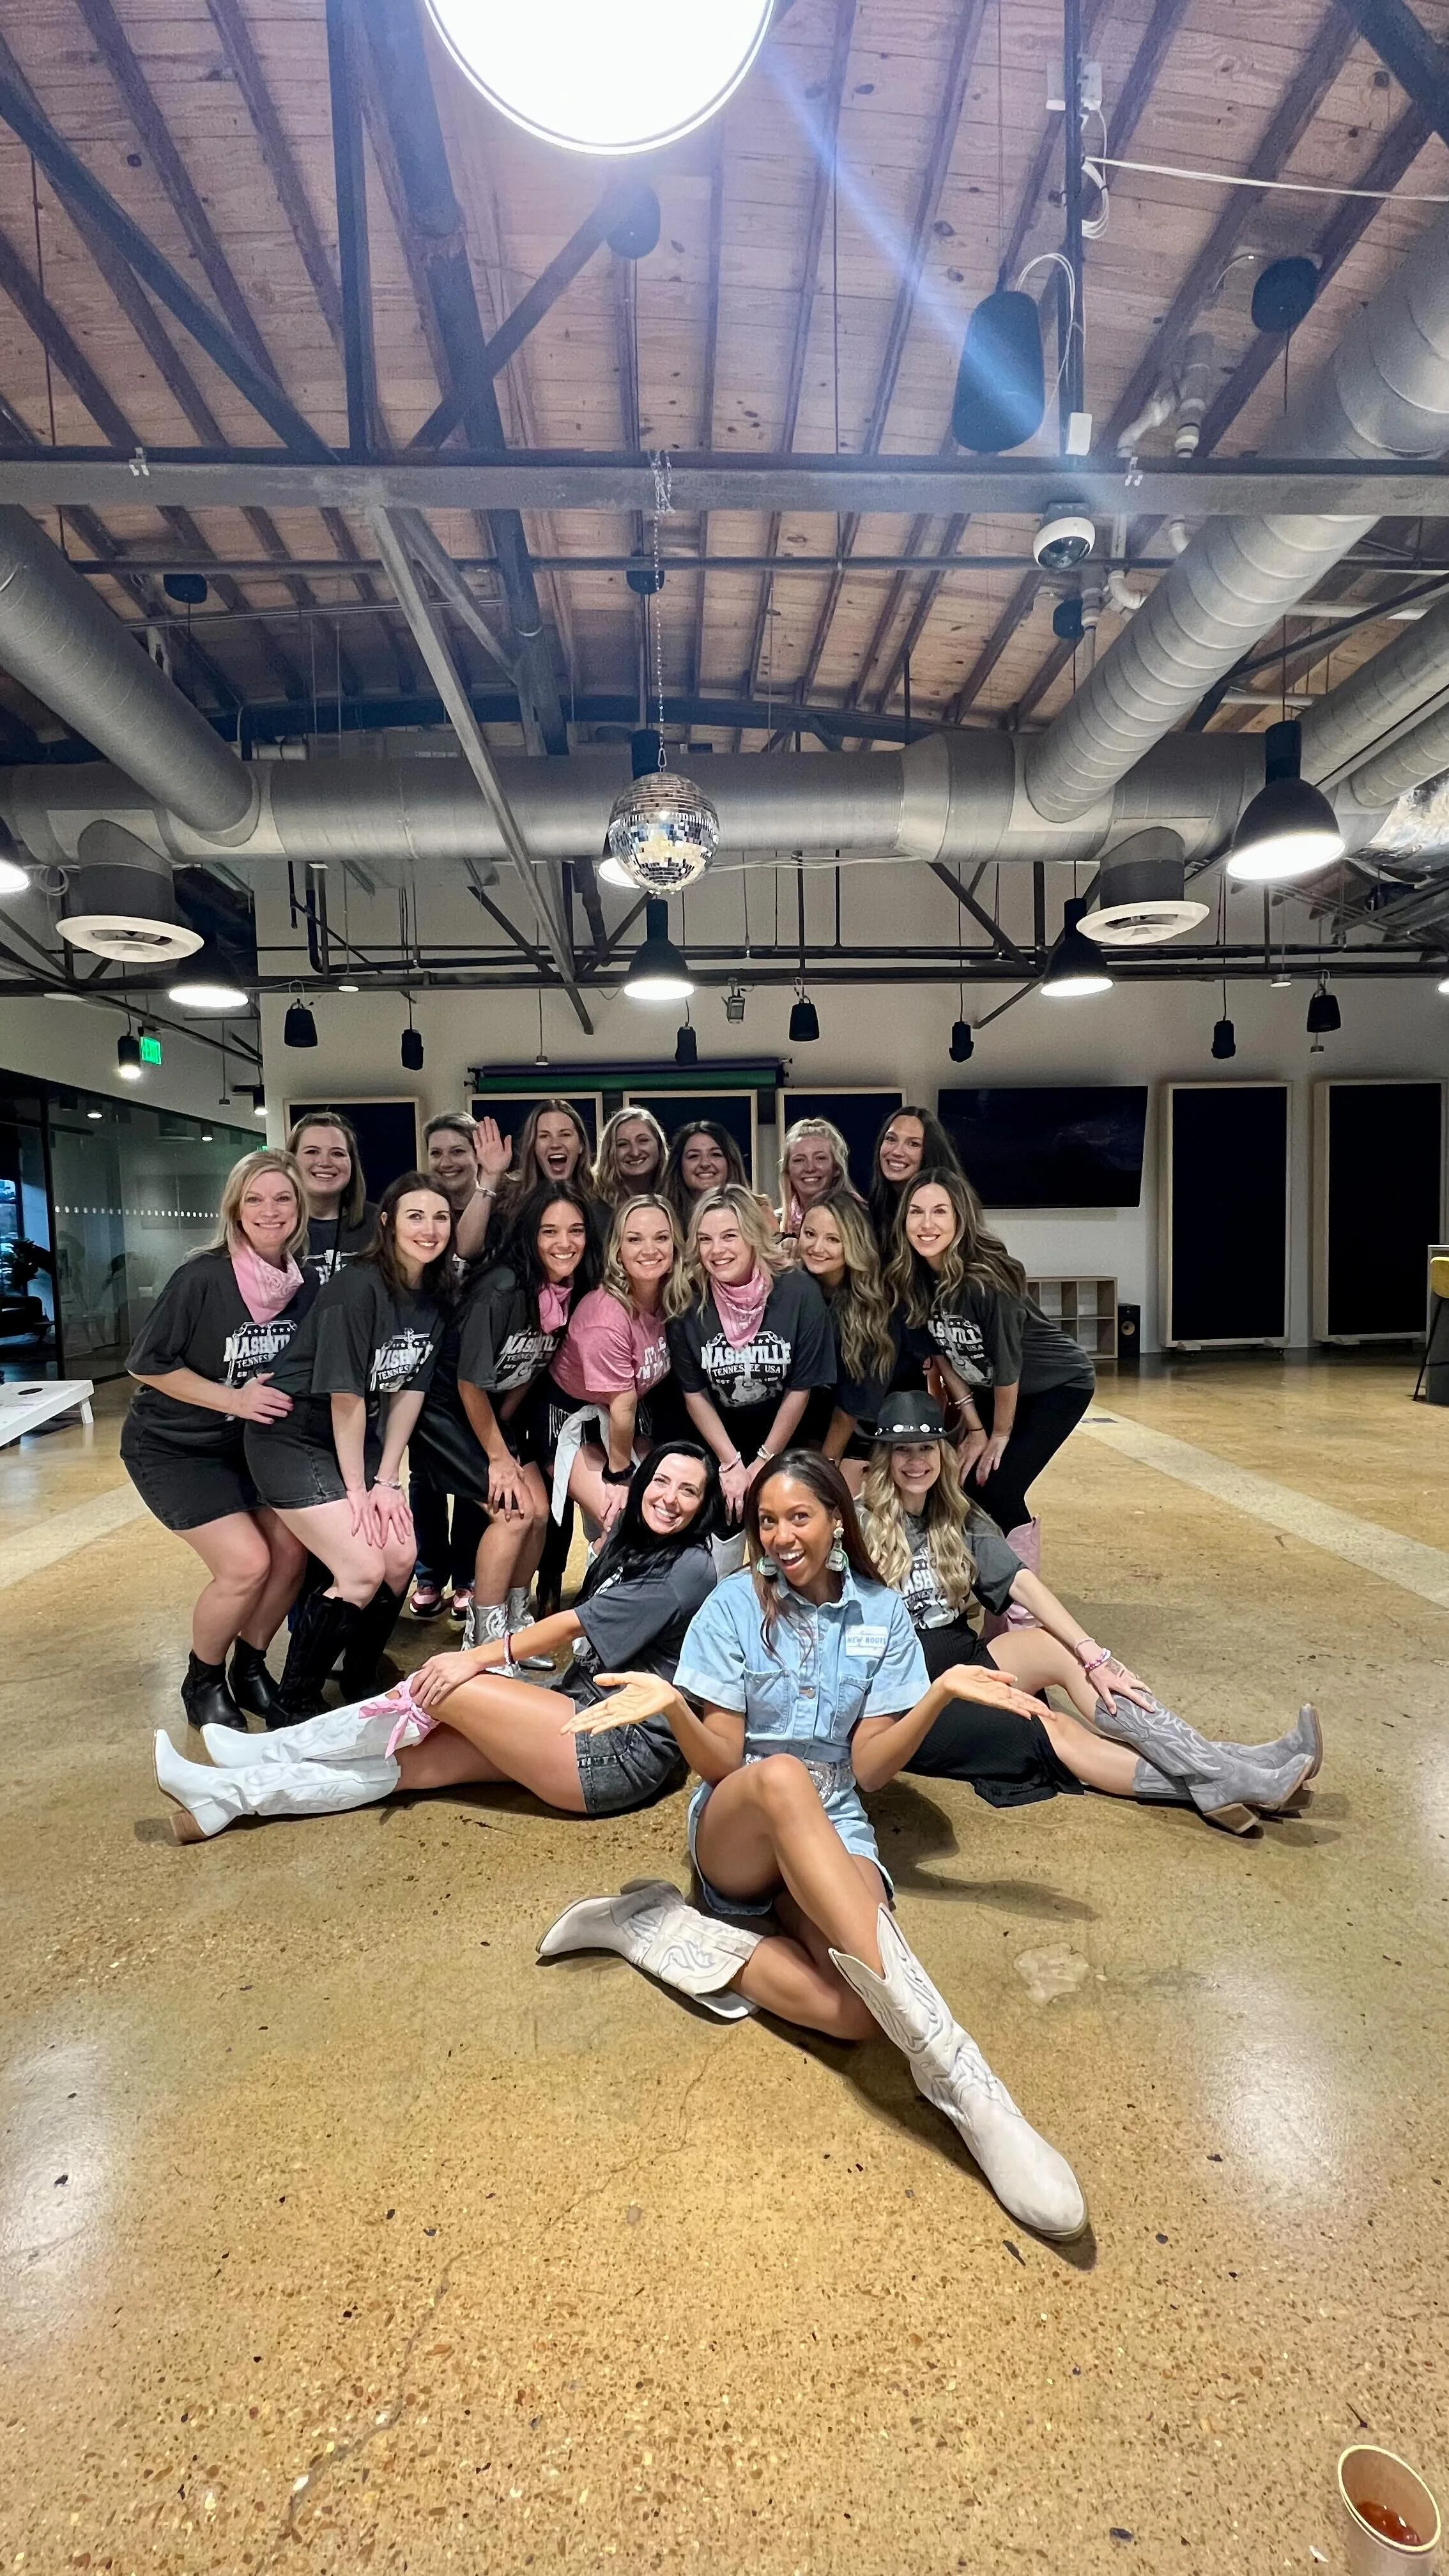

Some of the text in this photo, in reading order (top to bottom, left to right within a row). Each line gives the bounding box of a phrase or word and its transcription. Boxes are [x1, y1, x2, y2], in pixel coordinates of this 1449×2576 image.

[224, 1334, 291, 1362] NASHVI
[701, 1342, 792, 1369] NASHVILLE
[236, 1354, 271, 1368] TENNES
[377, 1365, 410, 1381] TENNES
[712, 1363, 781, 1377] TENNESEE USA
